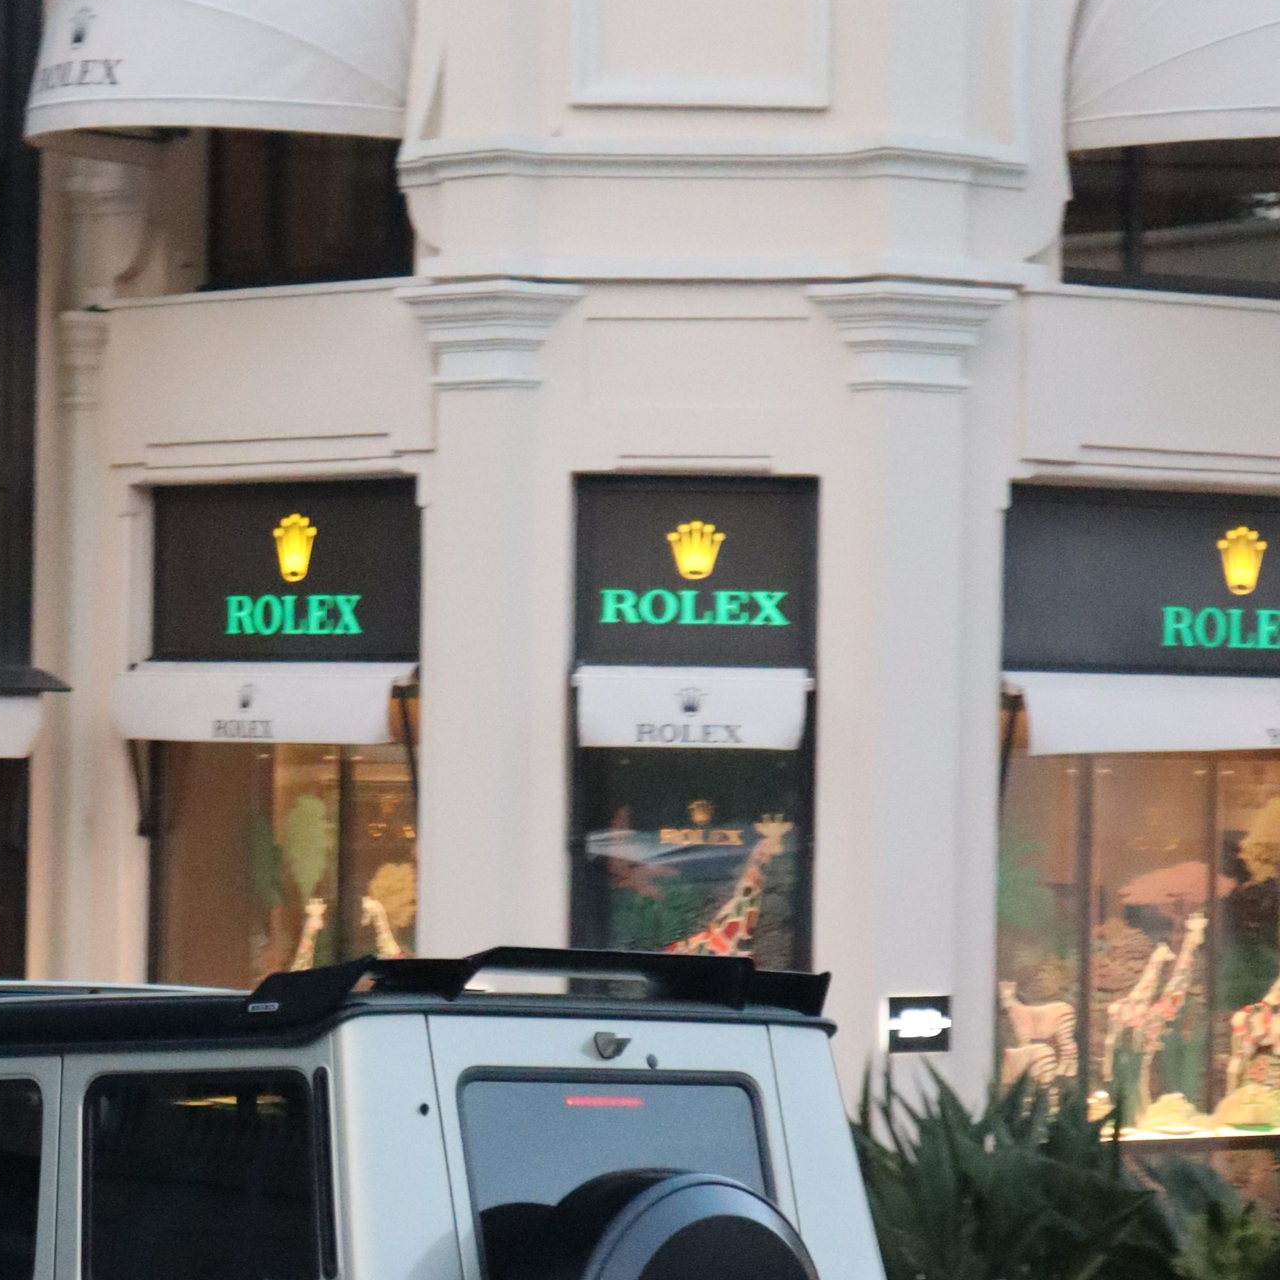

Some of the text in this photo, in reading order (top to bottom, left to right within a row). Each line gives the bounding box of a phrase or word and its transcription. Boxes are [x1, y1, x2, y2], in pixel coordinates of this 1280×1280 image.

[225, 593, 363, 635] ROLEX
[599, 588, 791, 626] ROLEX
[1162, 605, 1280, 649] ROLE
[634, 723, 744, 743] ROLEX
[660, 828, 744, 845] ROLEX
